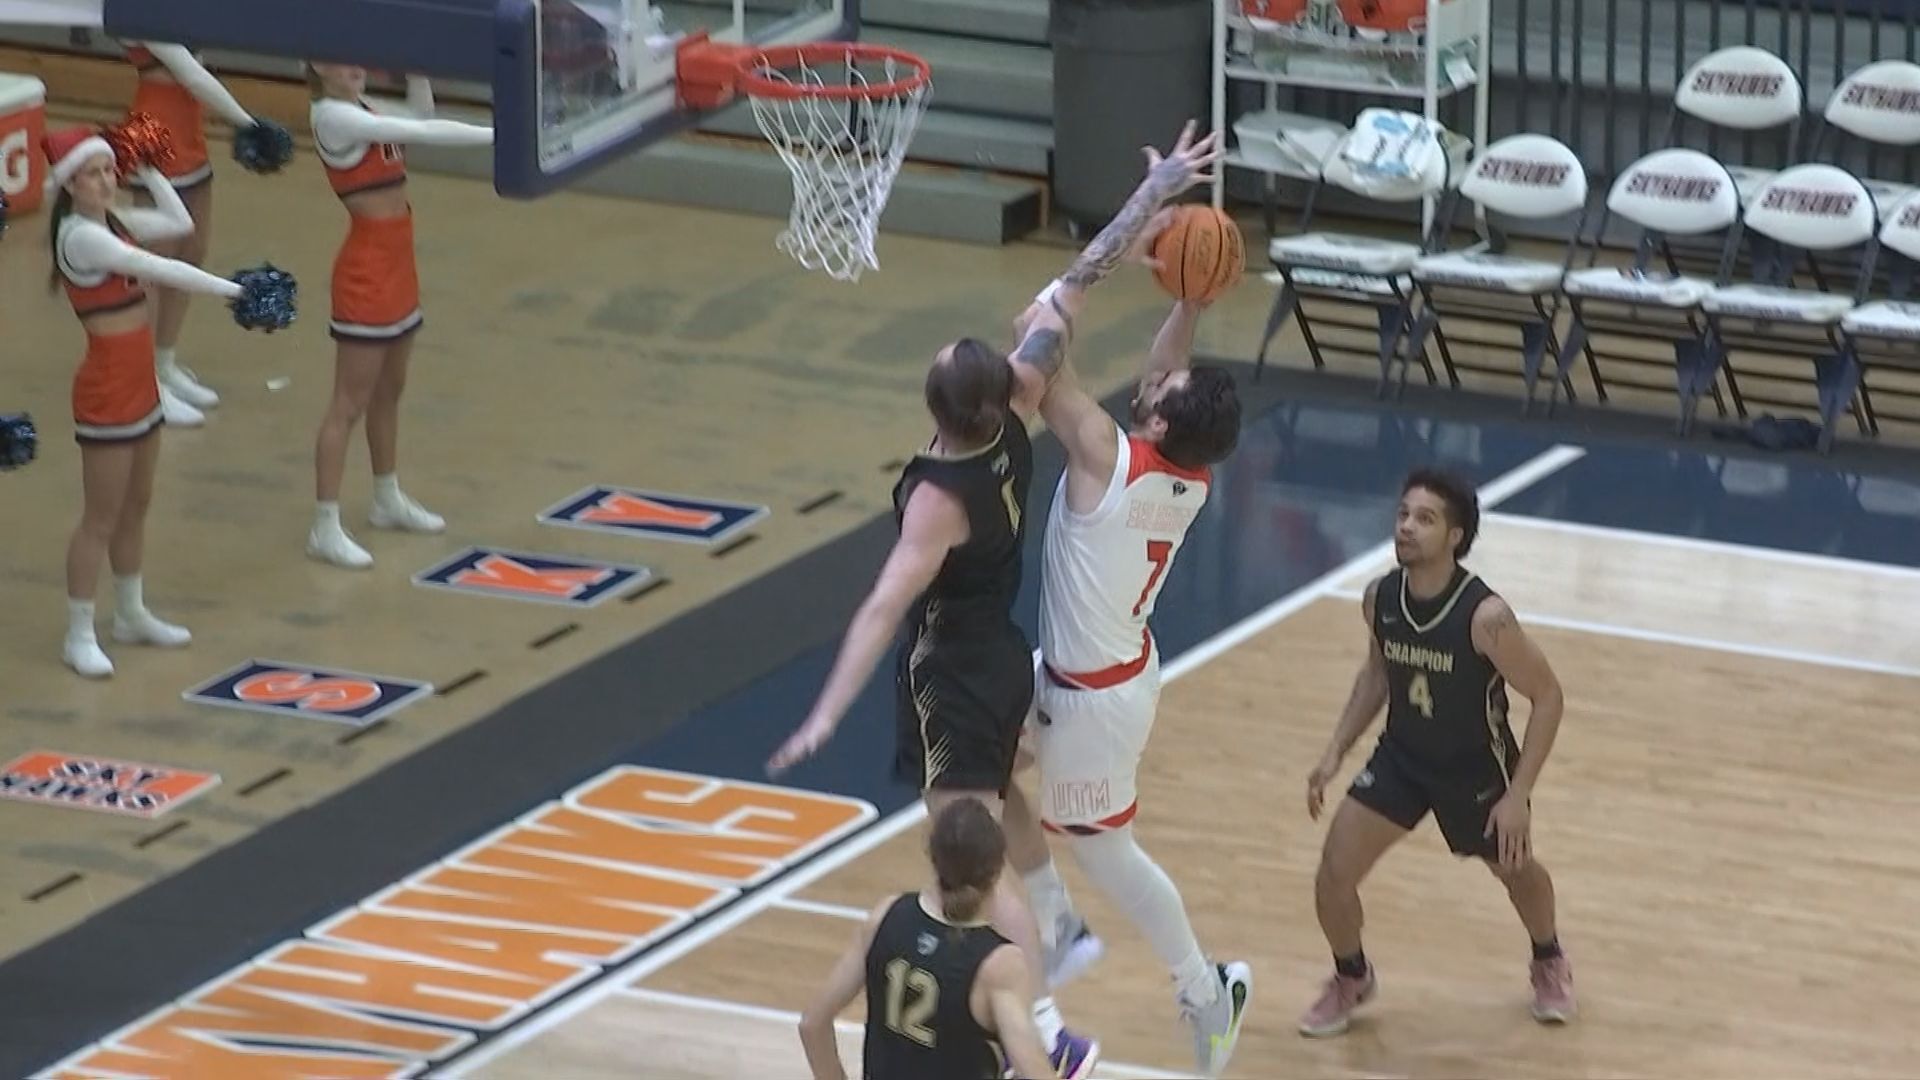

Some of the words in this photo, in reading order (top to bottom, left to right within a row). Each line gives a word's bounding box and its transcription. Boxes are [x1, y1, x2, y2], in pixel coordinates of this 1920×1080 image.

[0, 128, 29, 195] G
[572, 491, 725, 531] Y
[446, 552, 617, 599] K
[1132, 539, 1174, 617] 7
[1384, 640, 1455, 673] CHAMPION
[232, 668, 383, 713] S
[1408, 671, 1435, 720] 4
[49, 760, 172, 790] SKY
[1052, 778, 1111, 817] UTM
[885, 958, 941, 1049] 12
